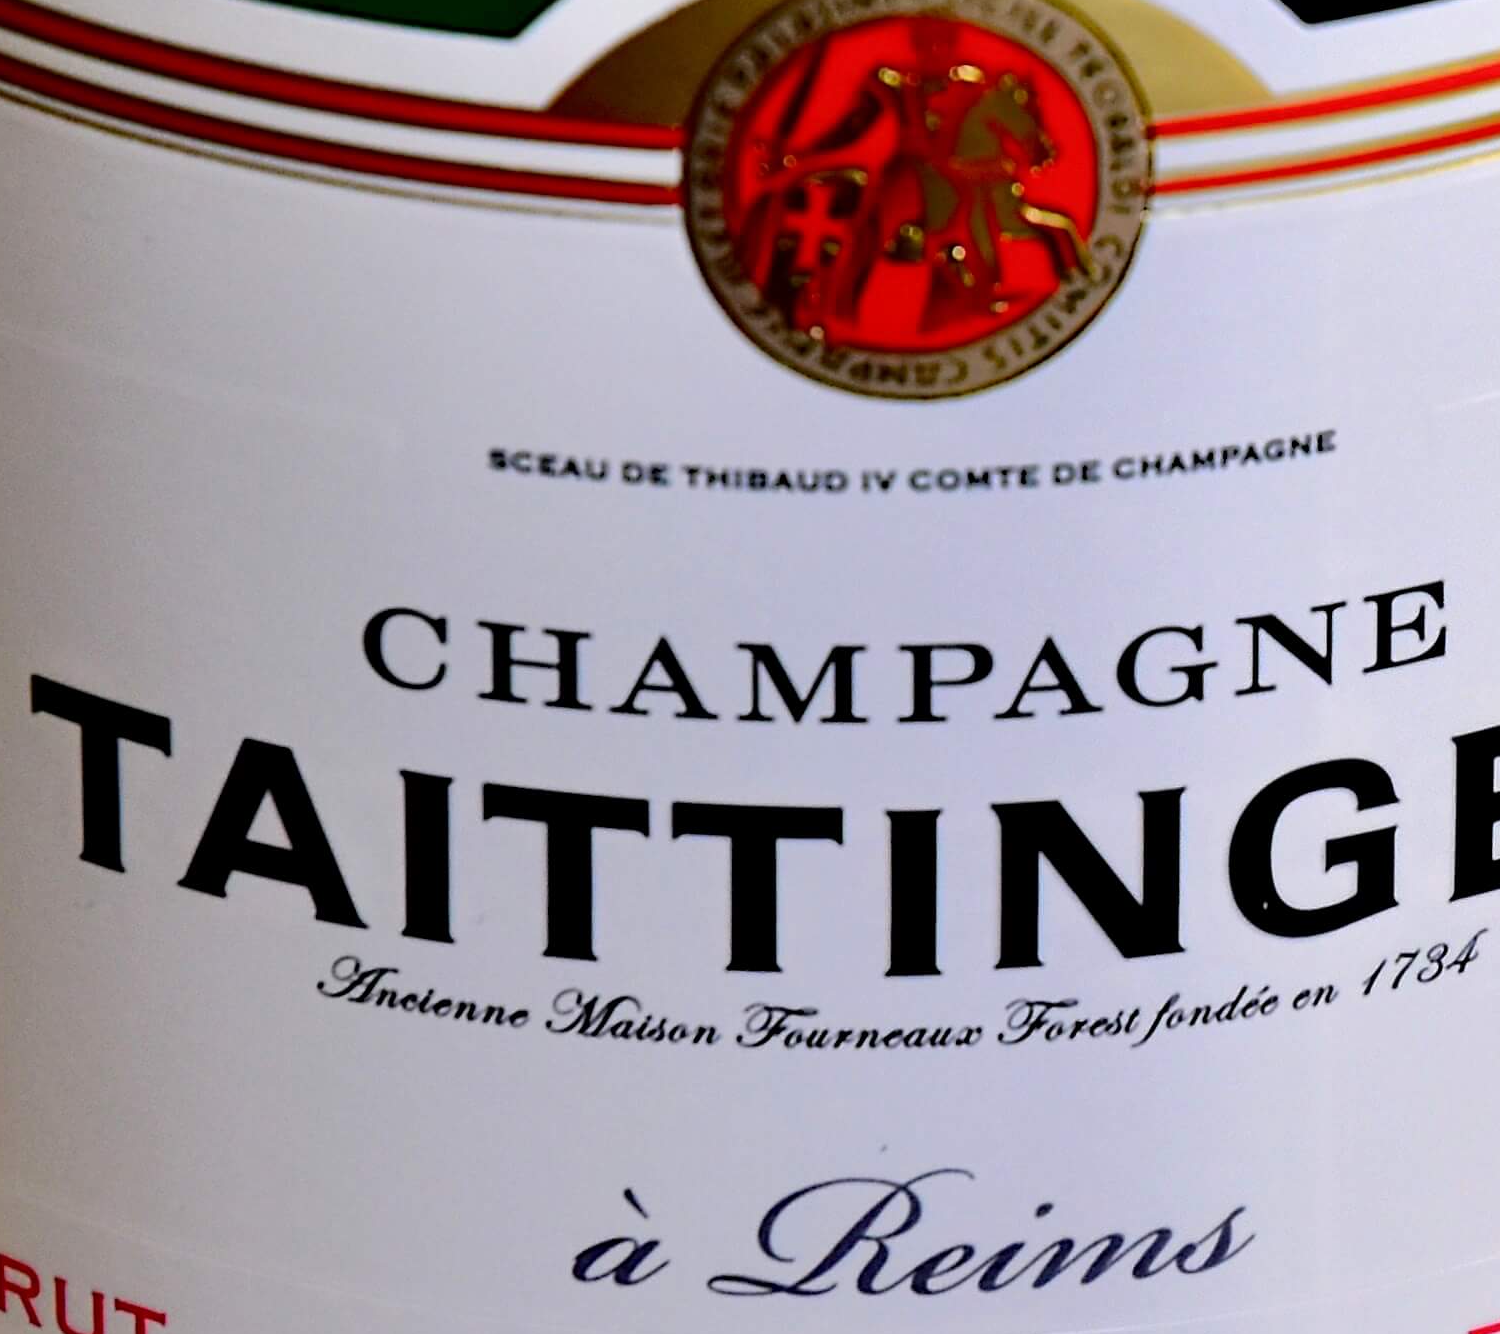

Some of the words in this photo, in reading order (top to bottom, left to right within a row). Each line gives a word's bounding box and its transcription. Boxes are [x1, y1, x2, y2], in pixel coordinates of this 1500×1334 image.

[487, 447, 610, 483] SCEAU
[620, 460, 672, 489] DE
[682, 463, 850, 495] THIBAUD
[859, 469, 900, 495] IV
[906, 463, 1040, 494] COMTE
[1051, 458, 1104, 487] DE
[1111, 428, 1338, 482] CHAMPAGNE
[362, 580, 1447, 724] CHAMPAGNE
[317, 956, 530, 1029] Ancienne
[545, 987, 719, 1045] Maison
[735, 1003, 984, 1050] Fourneaux
[998, 998, 1141, 1045] Forest
[1130, 984, 1280, 1049] fondée
[1291, 982, 1339, 1012] en
[1360, 927, 1490, 999] 1734
[571, 1188, 670, 1287] à
[706, 1168, 1255, 1297] Reims
